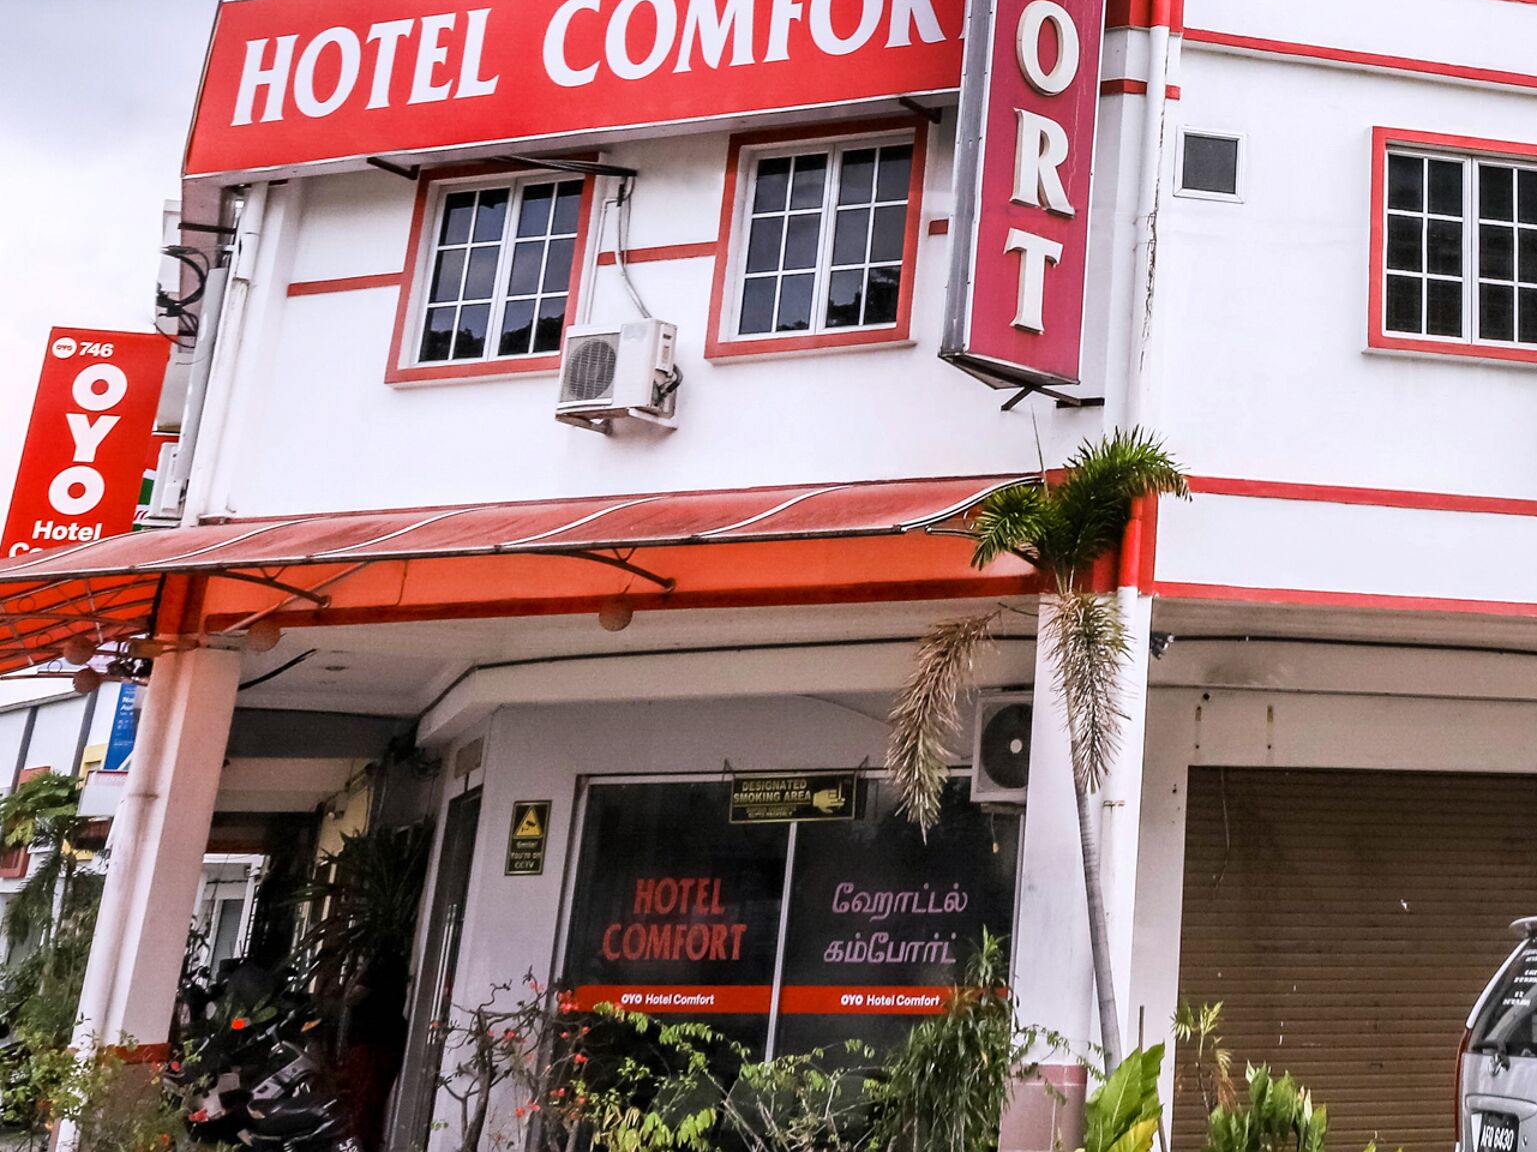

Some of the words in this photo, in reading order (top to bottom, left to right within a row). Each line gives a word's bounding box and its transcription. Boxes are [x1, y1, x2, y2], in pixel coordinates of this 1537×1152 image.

[230, 7, 500, 128] HOTEL
[79, 342, 114, 358] 746
[48, 363, 128, 516] OYO
[32, 520, 103, 542] Hotel
[733, 791, 780, 803] SMOKING
[783, 790, 811, 802] AREA
[742, 779, 808, 791] DESIGNATED
[632, 877, 726, 915] HOTEL
[832, 882, 969, 923] ஹோட்டல்
[602, 922, 748, 961] COMFORT
[823, 932, 958, 964] கம்போர்ட்
[621, 993, 643, 1004] OYO
[645, 993, 673, 1005] Hotel
[673, 993, 715, 1005] Comfort
[840, 994, 864, 1006] OYO
[866, 994, 896, 1006] Hotel
[896, 994, 940, 1006] Comfort
